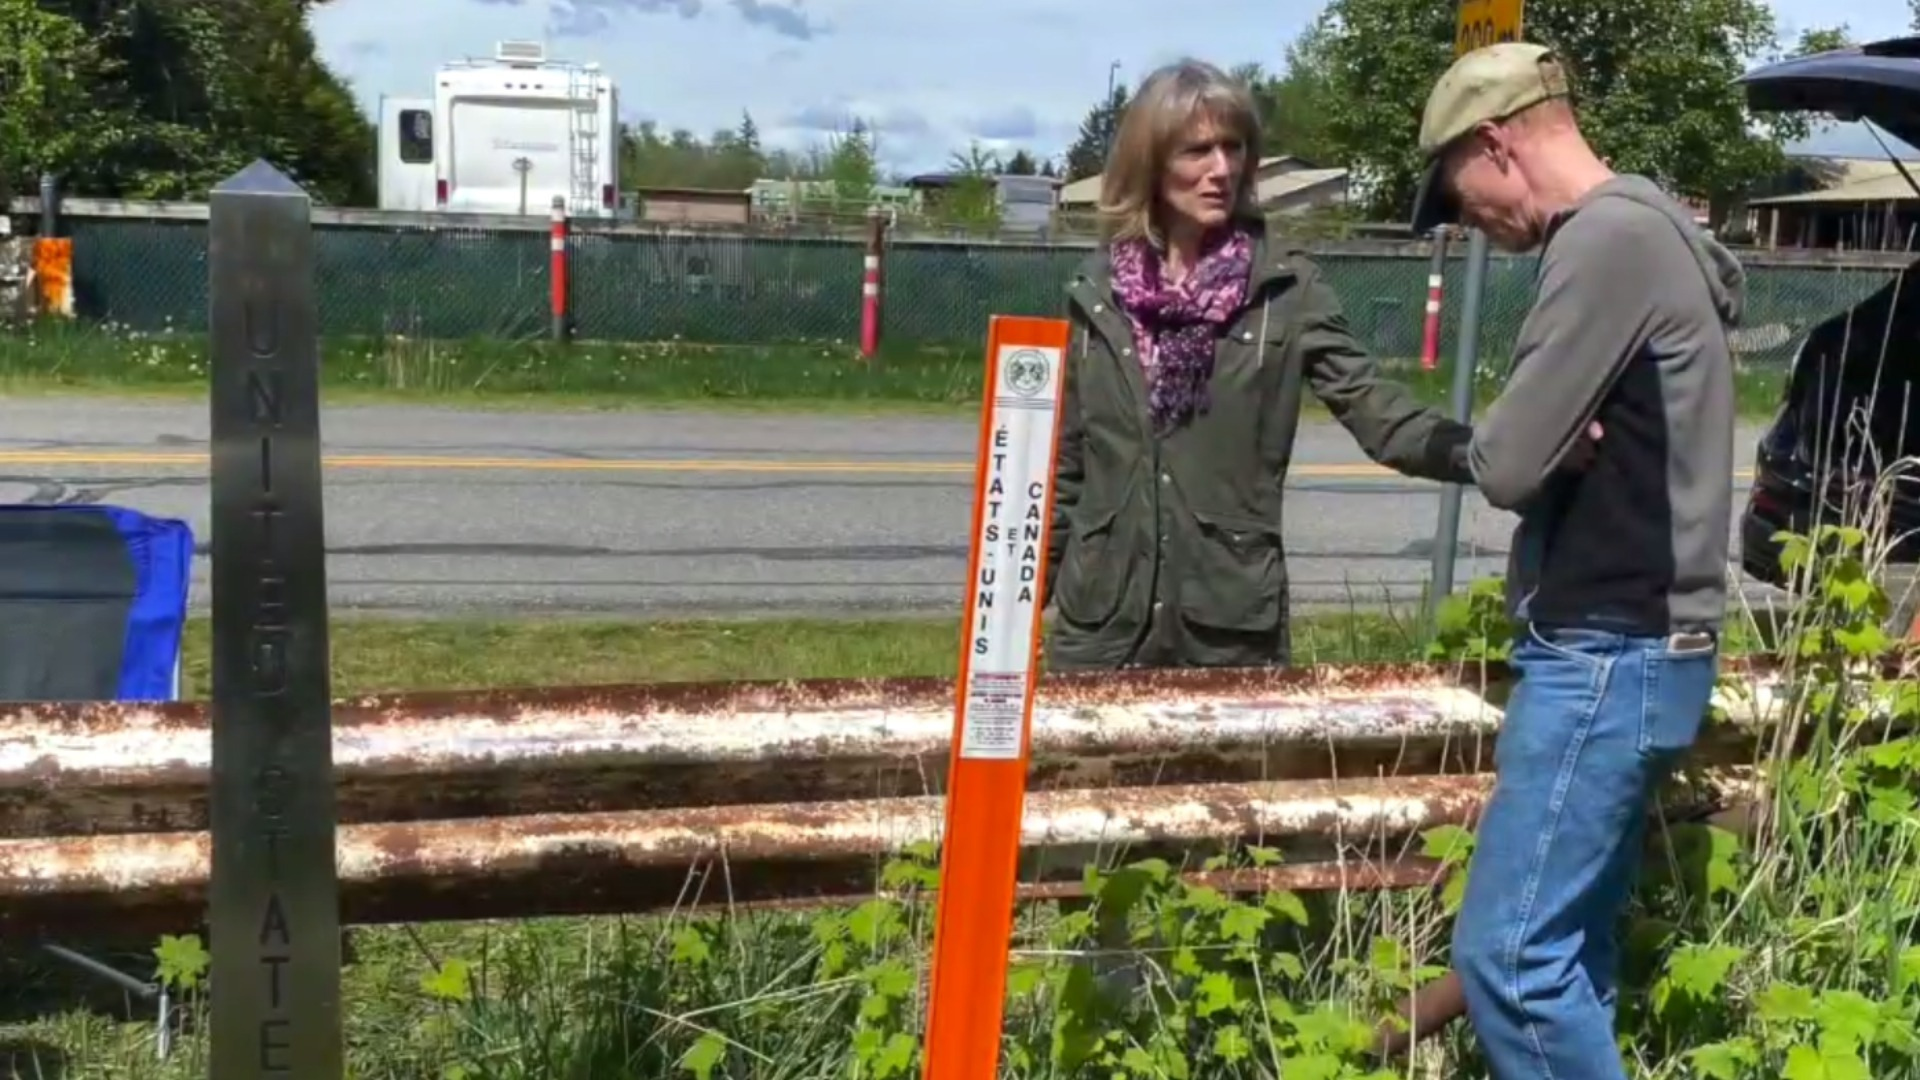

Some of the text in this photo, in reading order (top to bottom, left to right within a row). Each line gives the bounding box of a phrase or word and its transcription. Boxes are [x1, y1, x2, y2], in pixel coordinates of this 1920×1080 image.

[244, 297, 290, 694] UNITED
[974, 423, 1009, 655] ÉTATS-UNIS
[1005, 528, 1018, 556] ET
[1017, 482, 1044, 603] CANADA
